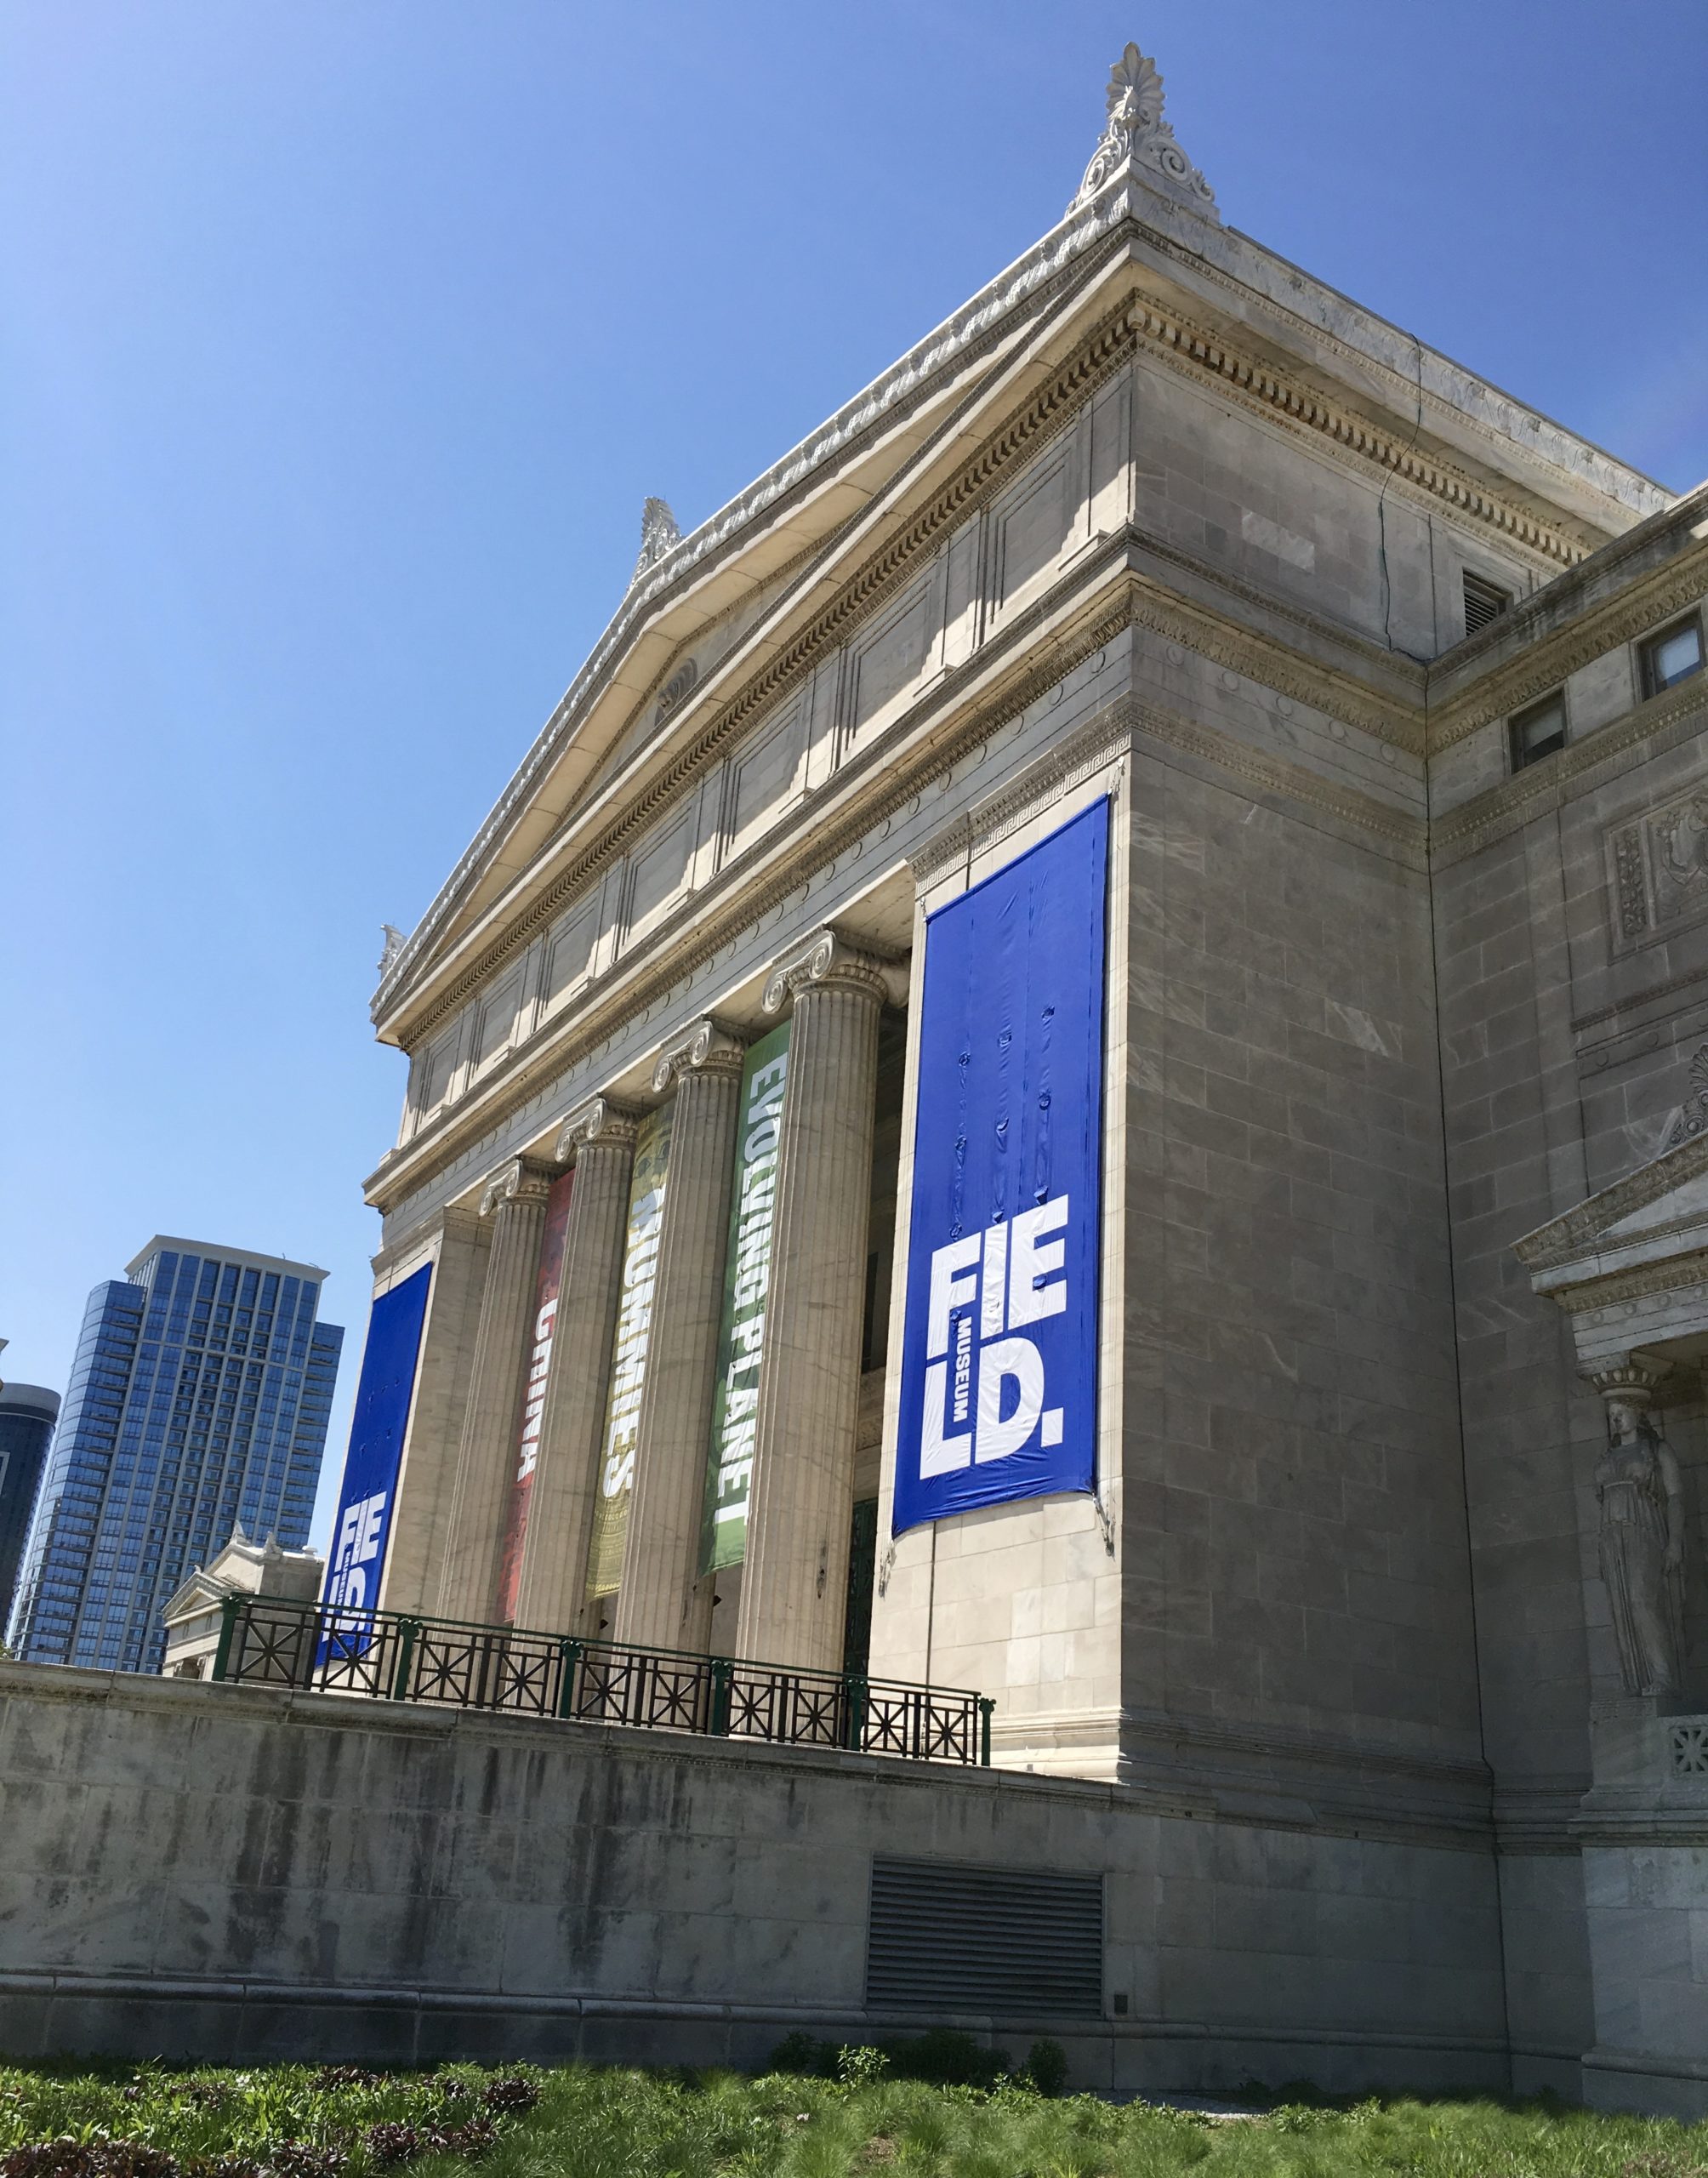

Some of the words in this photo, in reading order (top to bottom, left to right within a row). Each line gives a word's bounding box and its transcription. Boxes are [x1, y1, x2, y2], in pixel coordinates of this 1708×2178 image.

[734, 1052, 788, 1311] EVOLVING
[603, 1183, 666, 1497] MUMMIES
[715, 1314, 765, 1525] PLANET
[954, 1317, 971, 1422] MUSEUM
